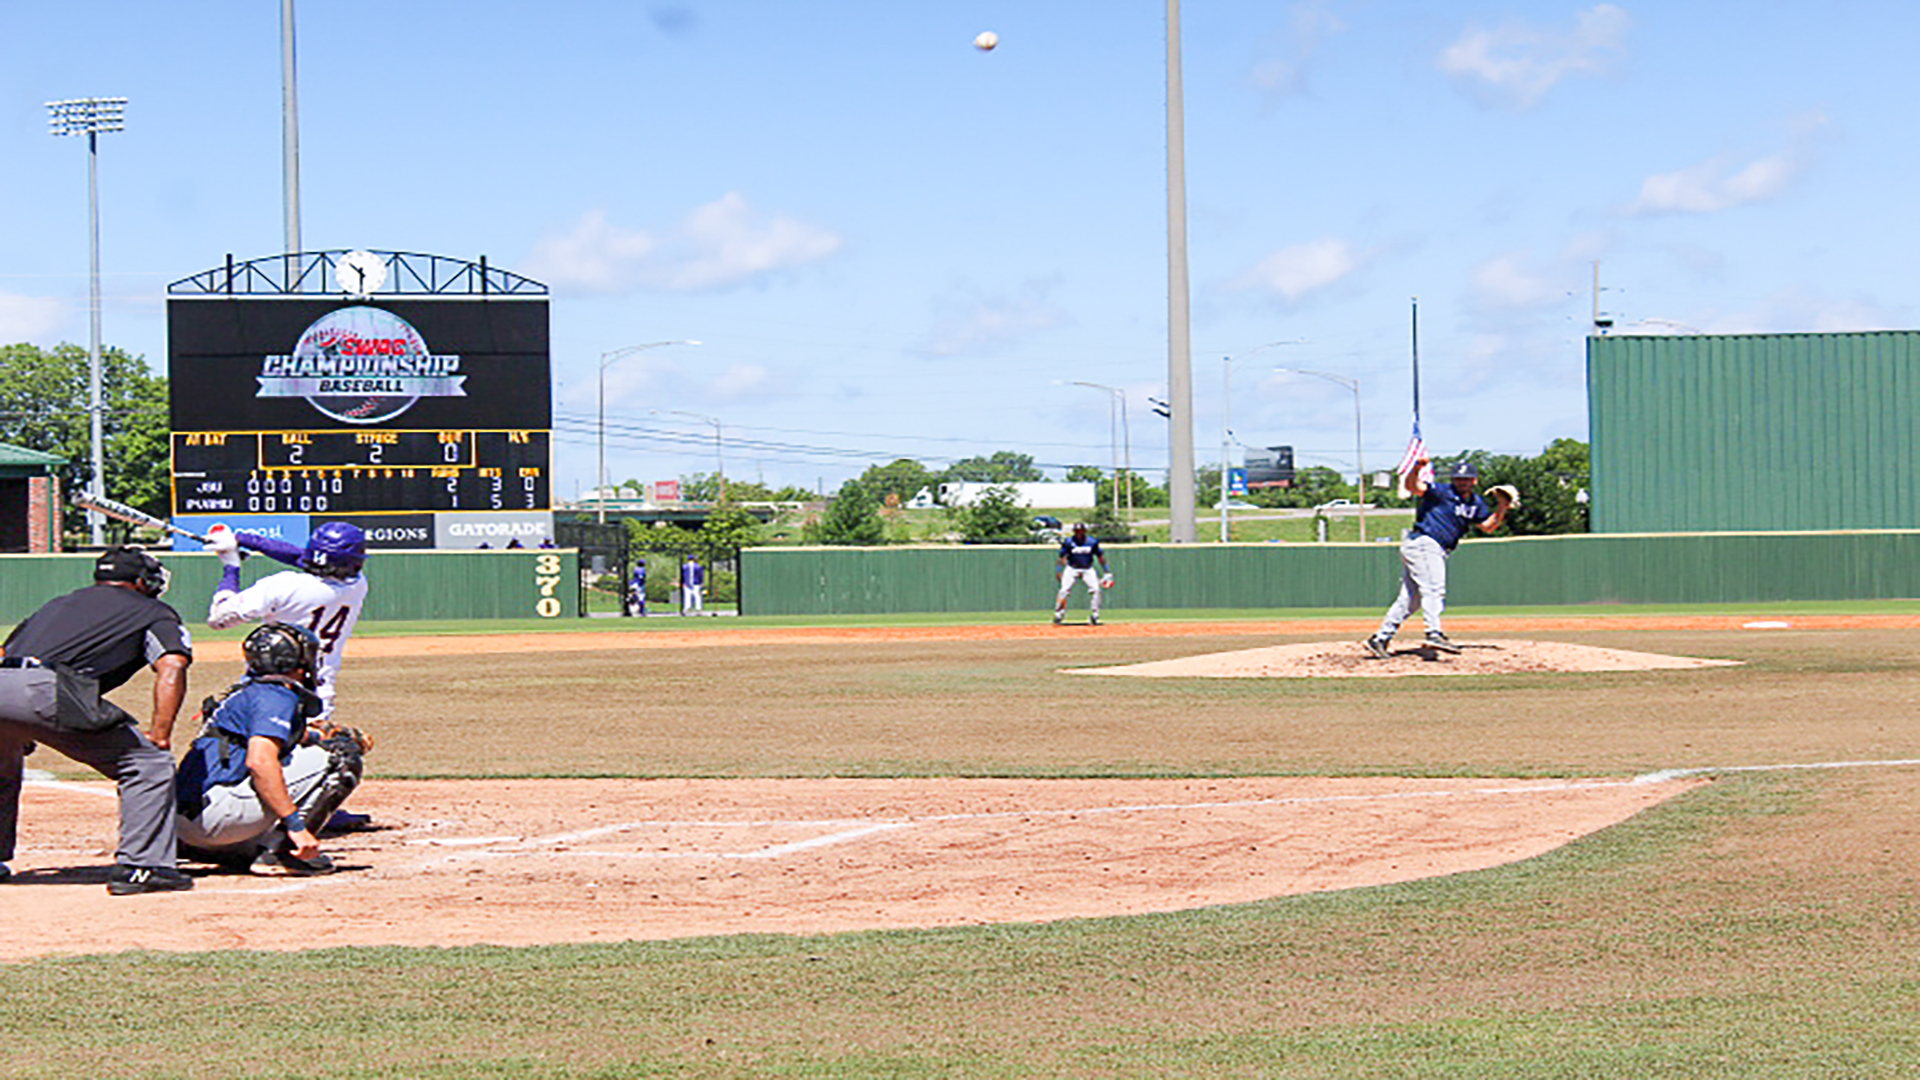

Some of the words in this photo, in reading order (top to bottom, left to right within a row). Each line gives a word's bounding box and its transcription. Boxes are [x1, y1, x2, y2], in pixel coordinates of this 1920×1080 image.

[262, 355, 460, 376] CHAMPIONSHIP
[319, 380, 403, 393] BASEBALL
[289, 444, 304, 464] 2
[369, 443, 383, 463] 2
[444, 443, 459, 462] 0
[247, 479, 260, 494] 0
[264, 479, 276, 494] 0
[280, 479, 292, 494] 0
[331, 478, 342, 494] 0
[447, 477, 458, 493] 2
[491, 476, 502, 491] 3
[524, 476, 535, 491] 0
[249, 496, 260, 511] 0
[265, 496, 276, 511] 0
[300, 496, 312, 511] 0
[316, 496, 328, 511] 0
[491, 493, 502, 509] 5
[526, 493, 535, 508] 3
[360, 528, 428, 541] EGIONS
[449, 522, 546, 537] GATORADE
[535, 554, 561, 618] 370
[309, 604, 350, 655] 14
